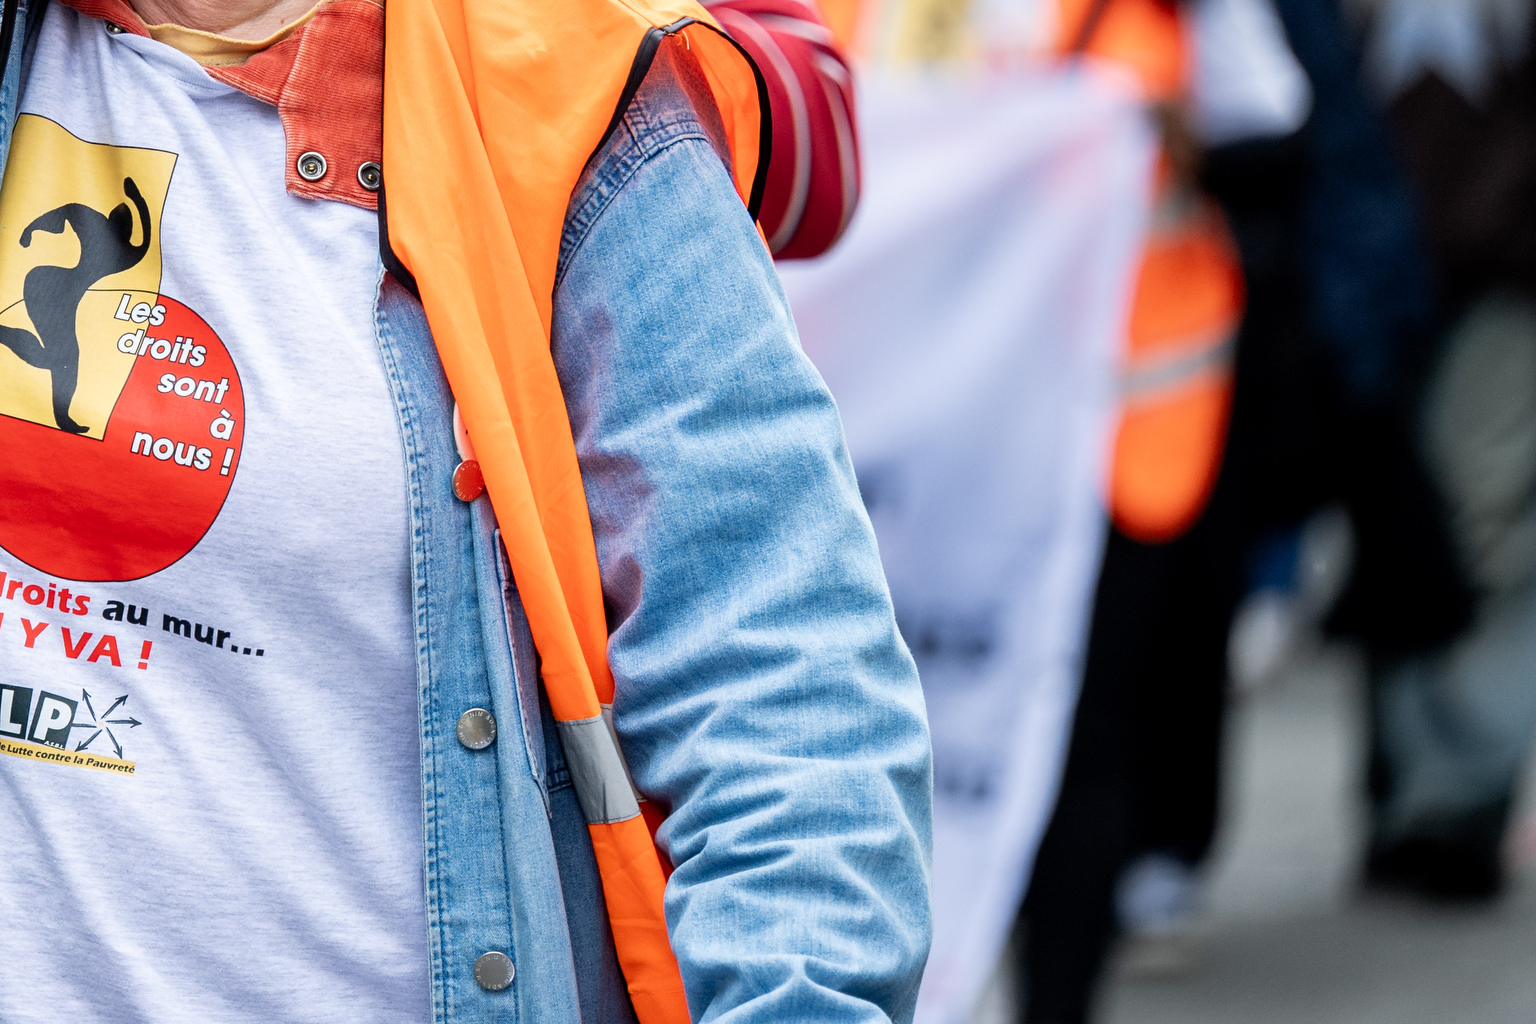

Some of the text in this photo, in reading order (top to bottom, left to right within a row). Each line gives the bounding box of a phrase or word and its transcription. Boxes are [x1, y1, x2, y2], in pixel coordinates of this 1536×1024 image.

[114, 294, 166, 326] Les
[117, 329, 207, 367] droits
[157, 373, 229, 404] sont
[210, 408, 236, 441] à
[131, 431, 235, 476] nous !
[21, 617, 49, 649] Y
[61, 627, 121, 667] VA
[138, 640, 153, 670] !
[102, 600, 149, 626] au
[163, 613, 264, 657] mur...
[7, 744, 34, 757] Lutte
[35, 751, 72, 763] contre
[73, 756, 84, 765] la
[85, 757, 136, 774] Pauvreté
